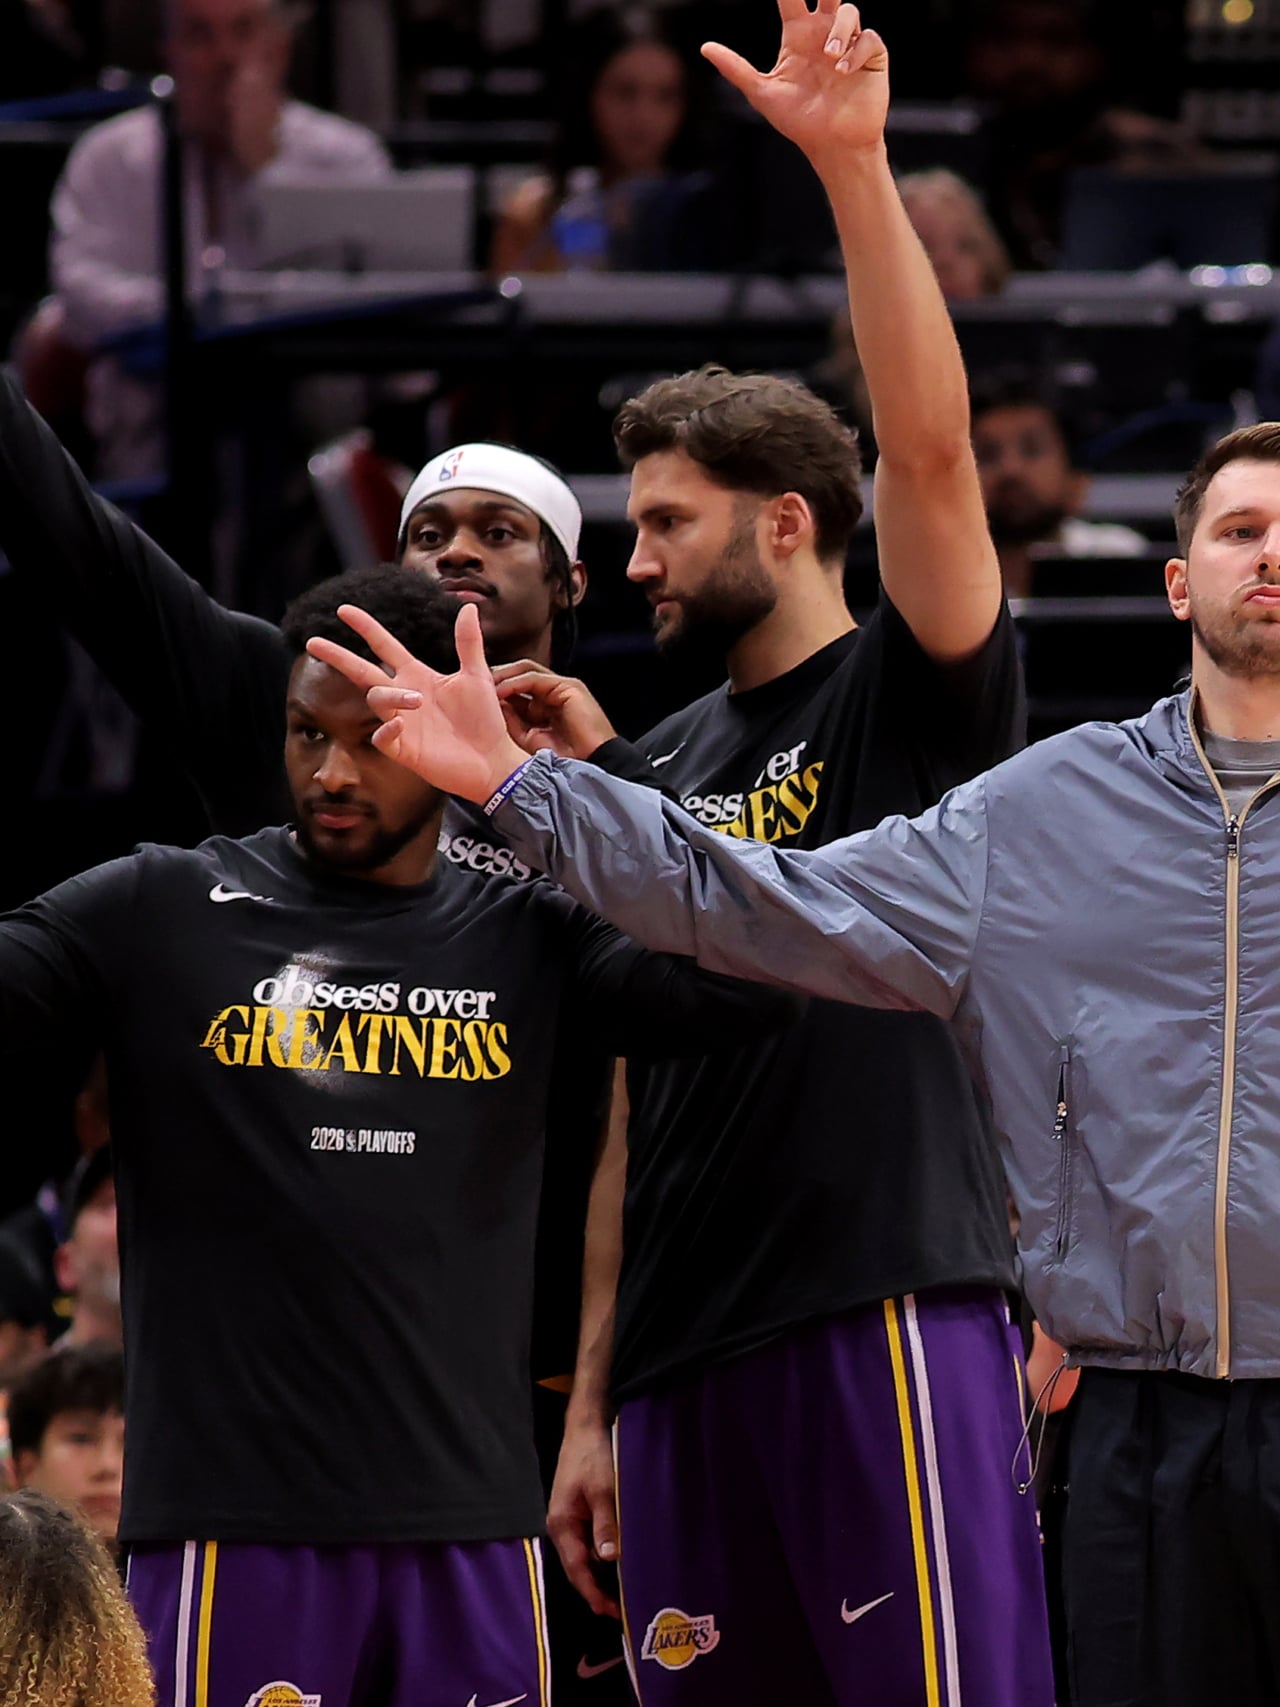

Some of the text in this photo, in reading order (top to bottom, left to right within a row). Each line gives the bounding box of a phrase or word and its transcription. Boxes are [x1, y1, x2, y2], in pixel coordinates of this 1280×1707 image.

[253, 964, 496, 1019] obsess over
[213, 1004, 512, 1081] GREATNESS
[311, 1126, 416, 1154] 2026 PLAYOFFS
[647, 1626, 711, 1655] LAKERS
